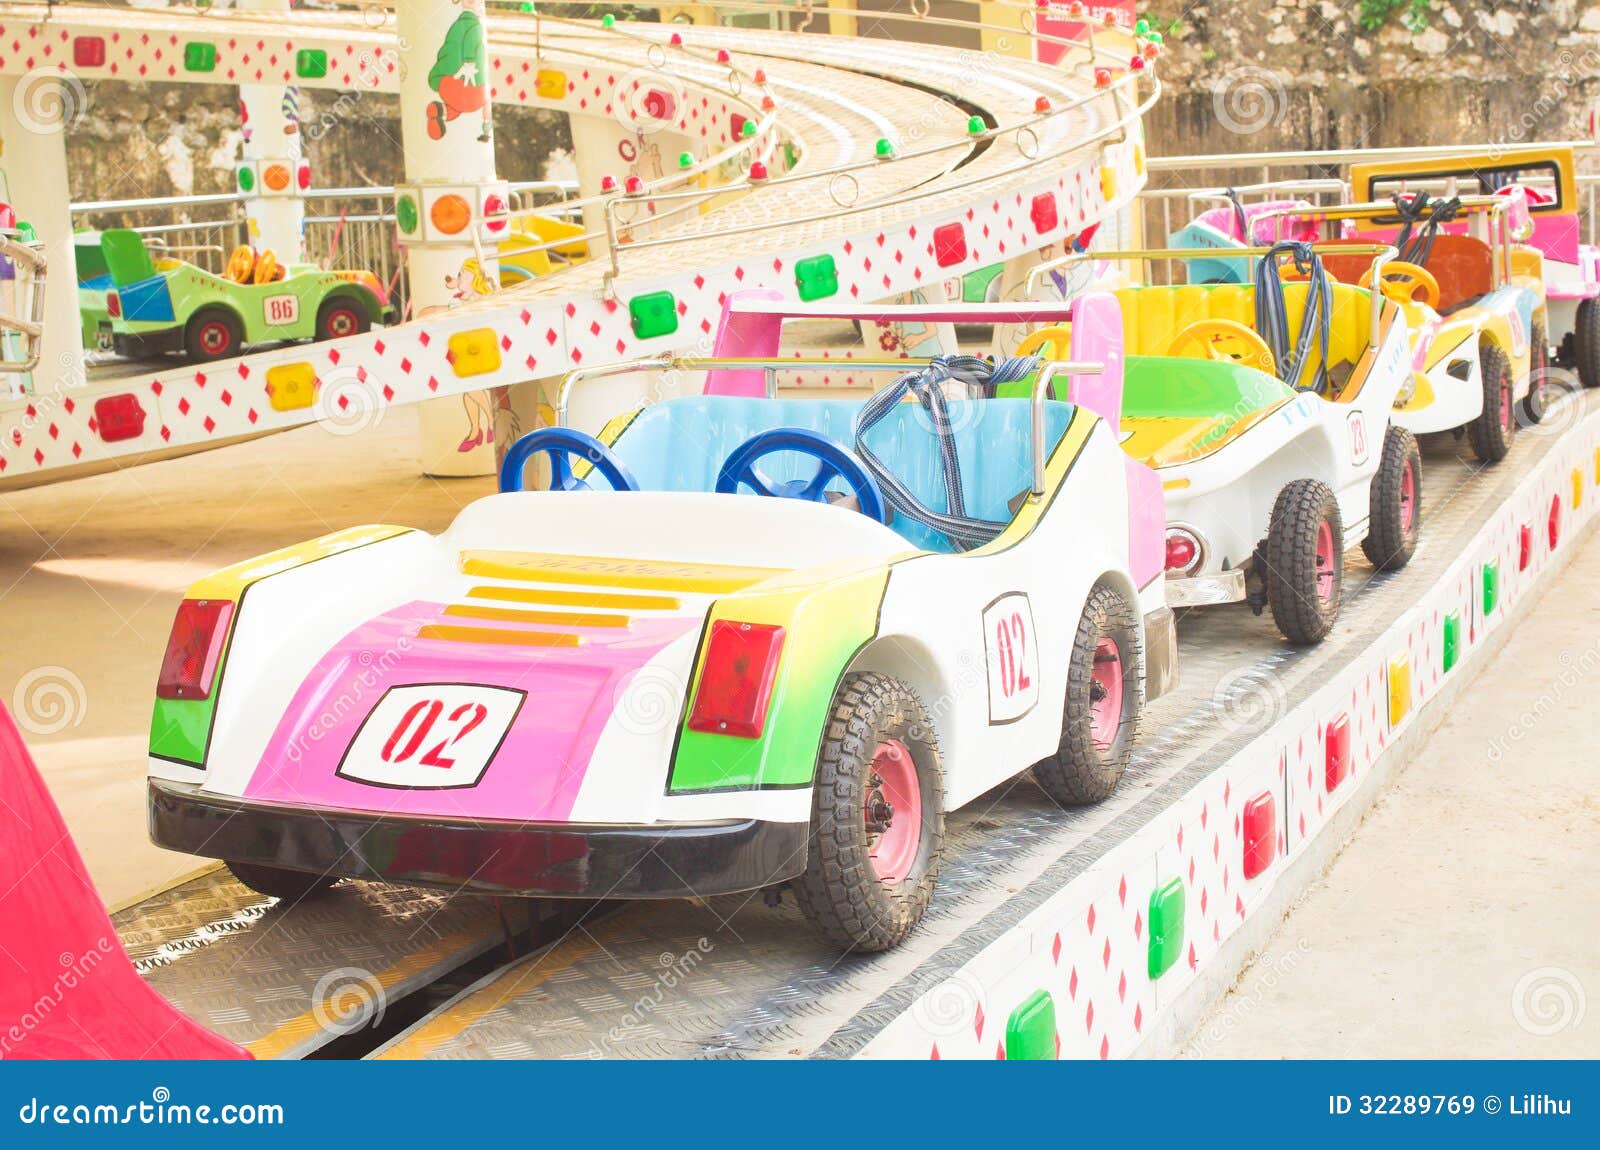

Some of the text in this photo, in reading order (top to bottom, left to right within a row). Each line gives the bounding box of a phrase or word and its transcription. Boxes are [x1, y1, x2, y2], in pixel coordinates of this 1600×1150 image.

[270, 299, 294, 321] 86
[996, 612, 1031, 698] 02
[381, 699, 488, 769] 02
